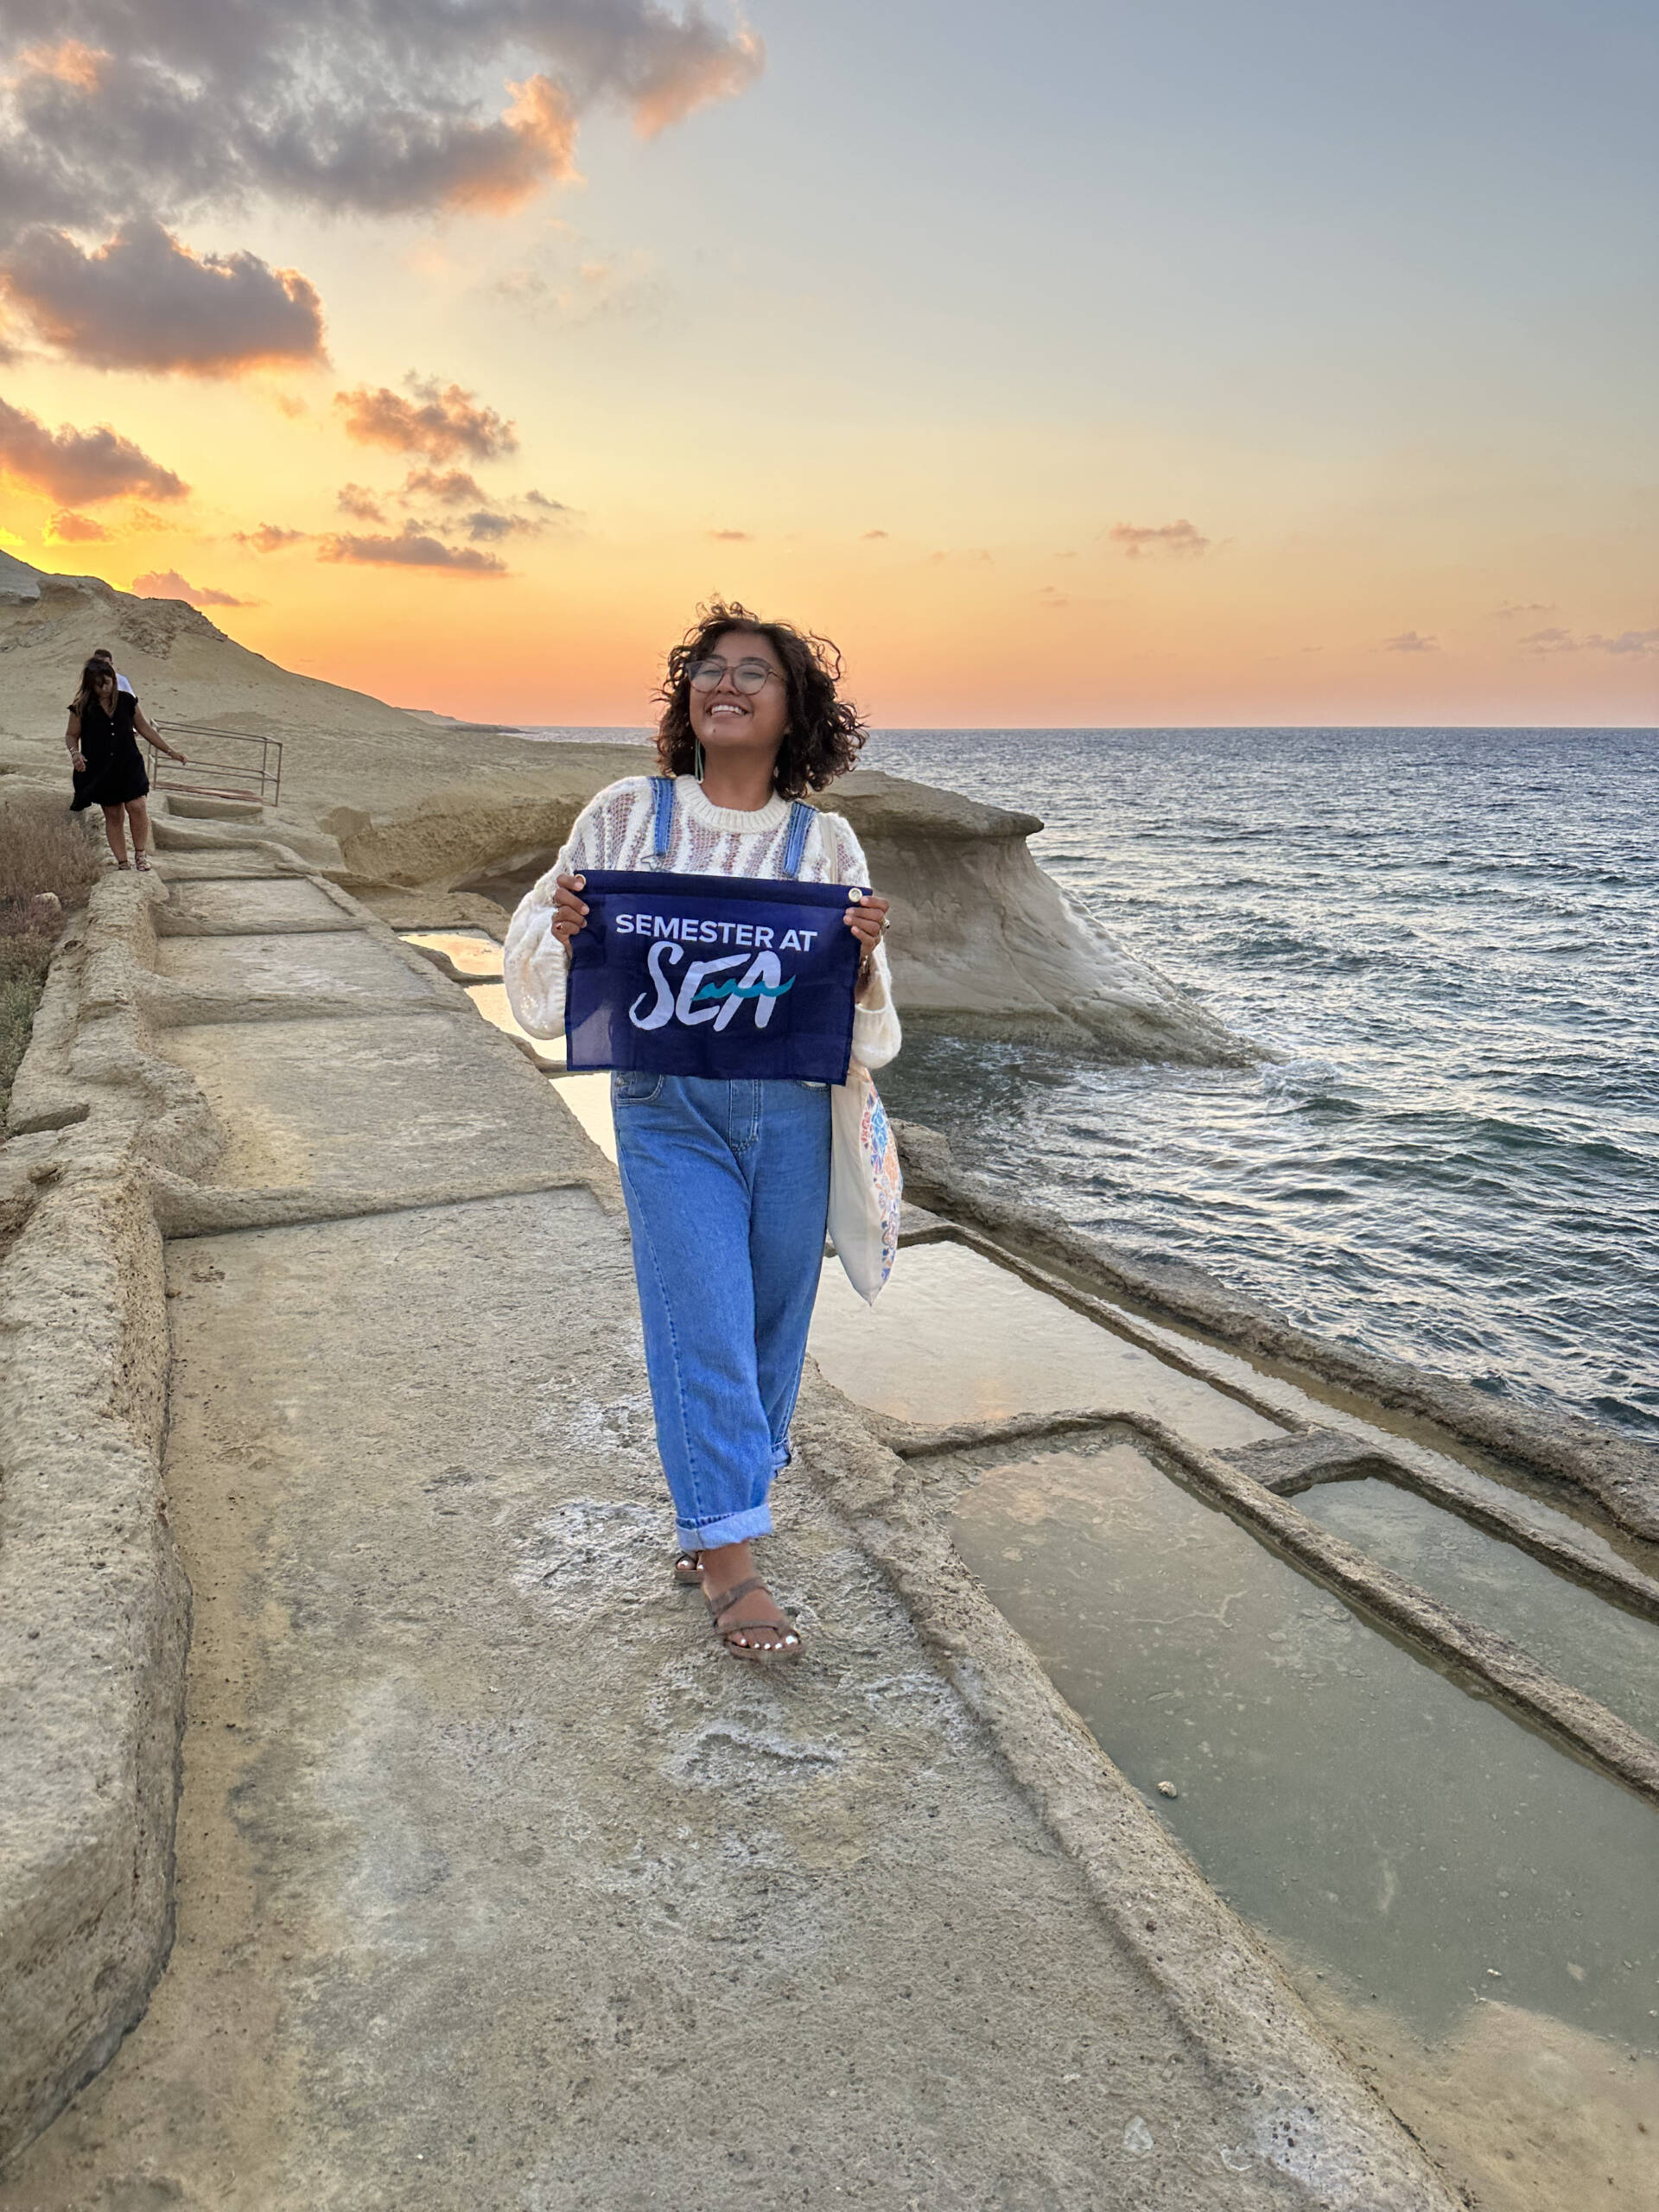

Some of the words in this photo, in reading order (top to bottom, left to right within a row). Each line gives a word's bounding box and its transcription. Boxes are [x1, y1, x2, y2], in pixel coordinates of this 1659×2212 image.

[615, 913, 774, 949] SEMESTER
[779, 929, 817, 951] AT
[629, 941, 793, 1032] SEA
